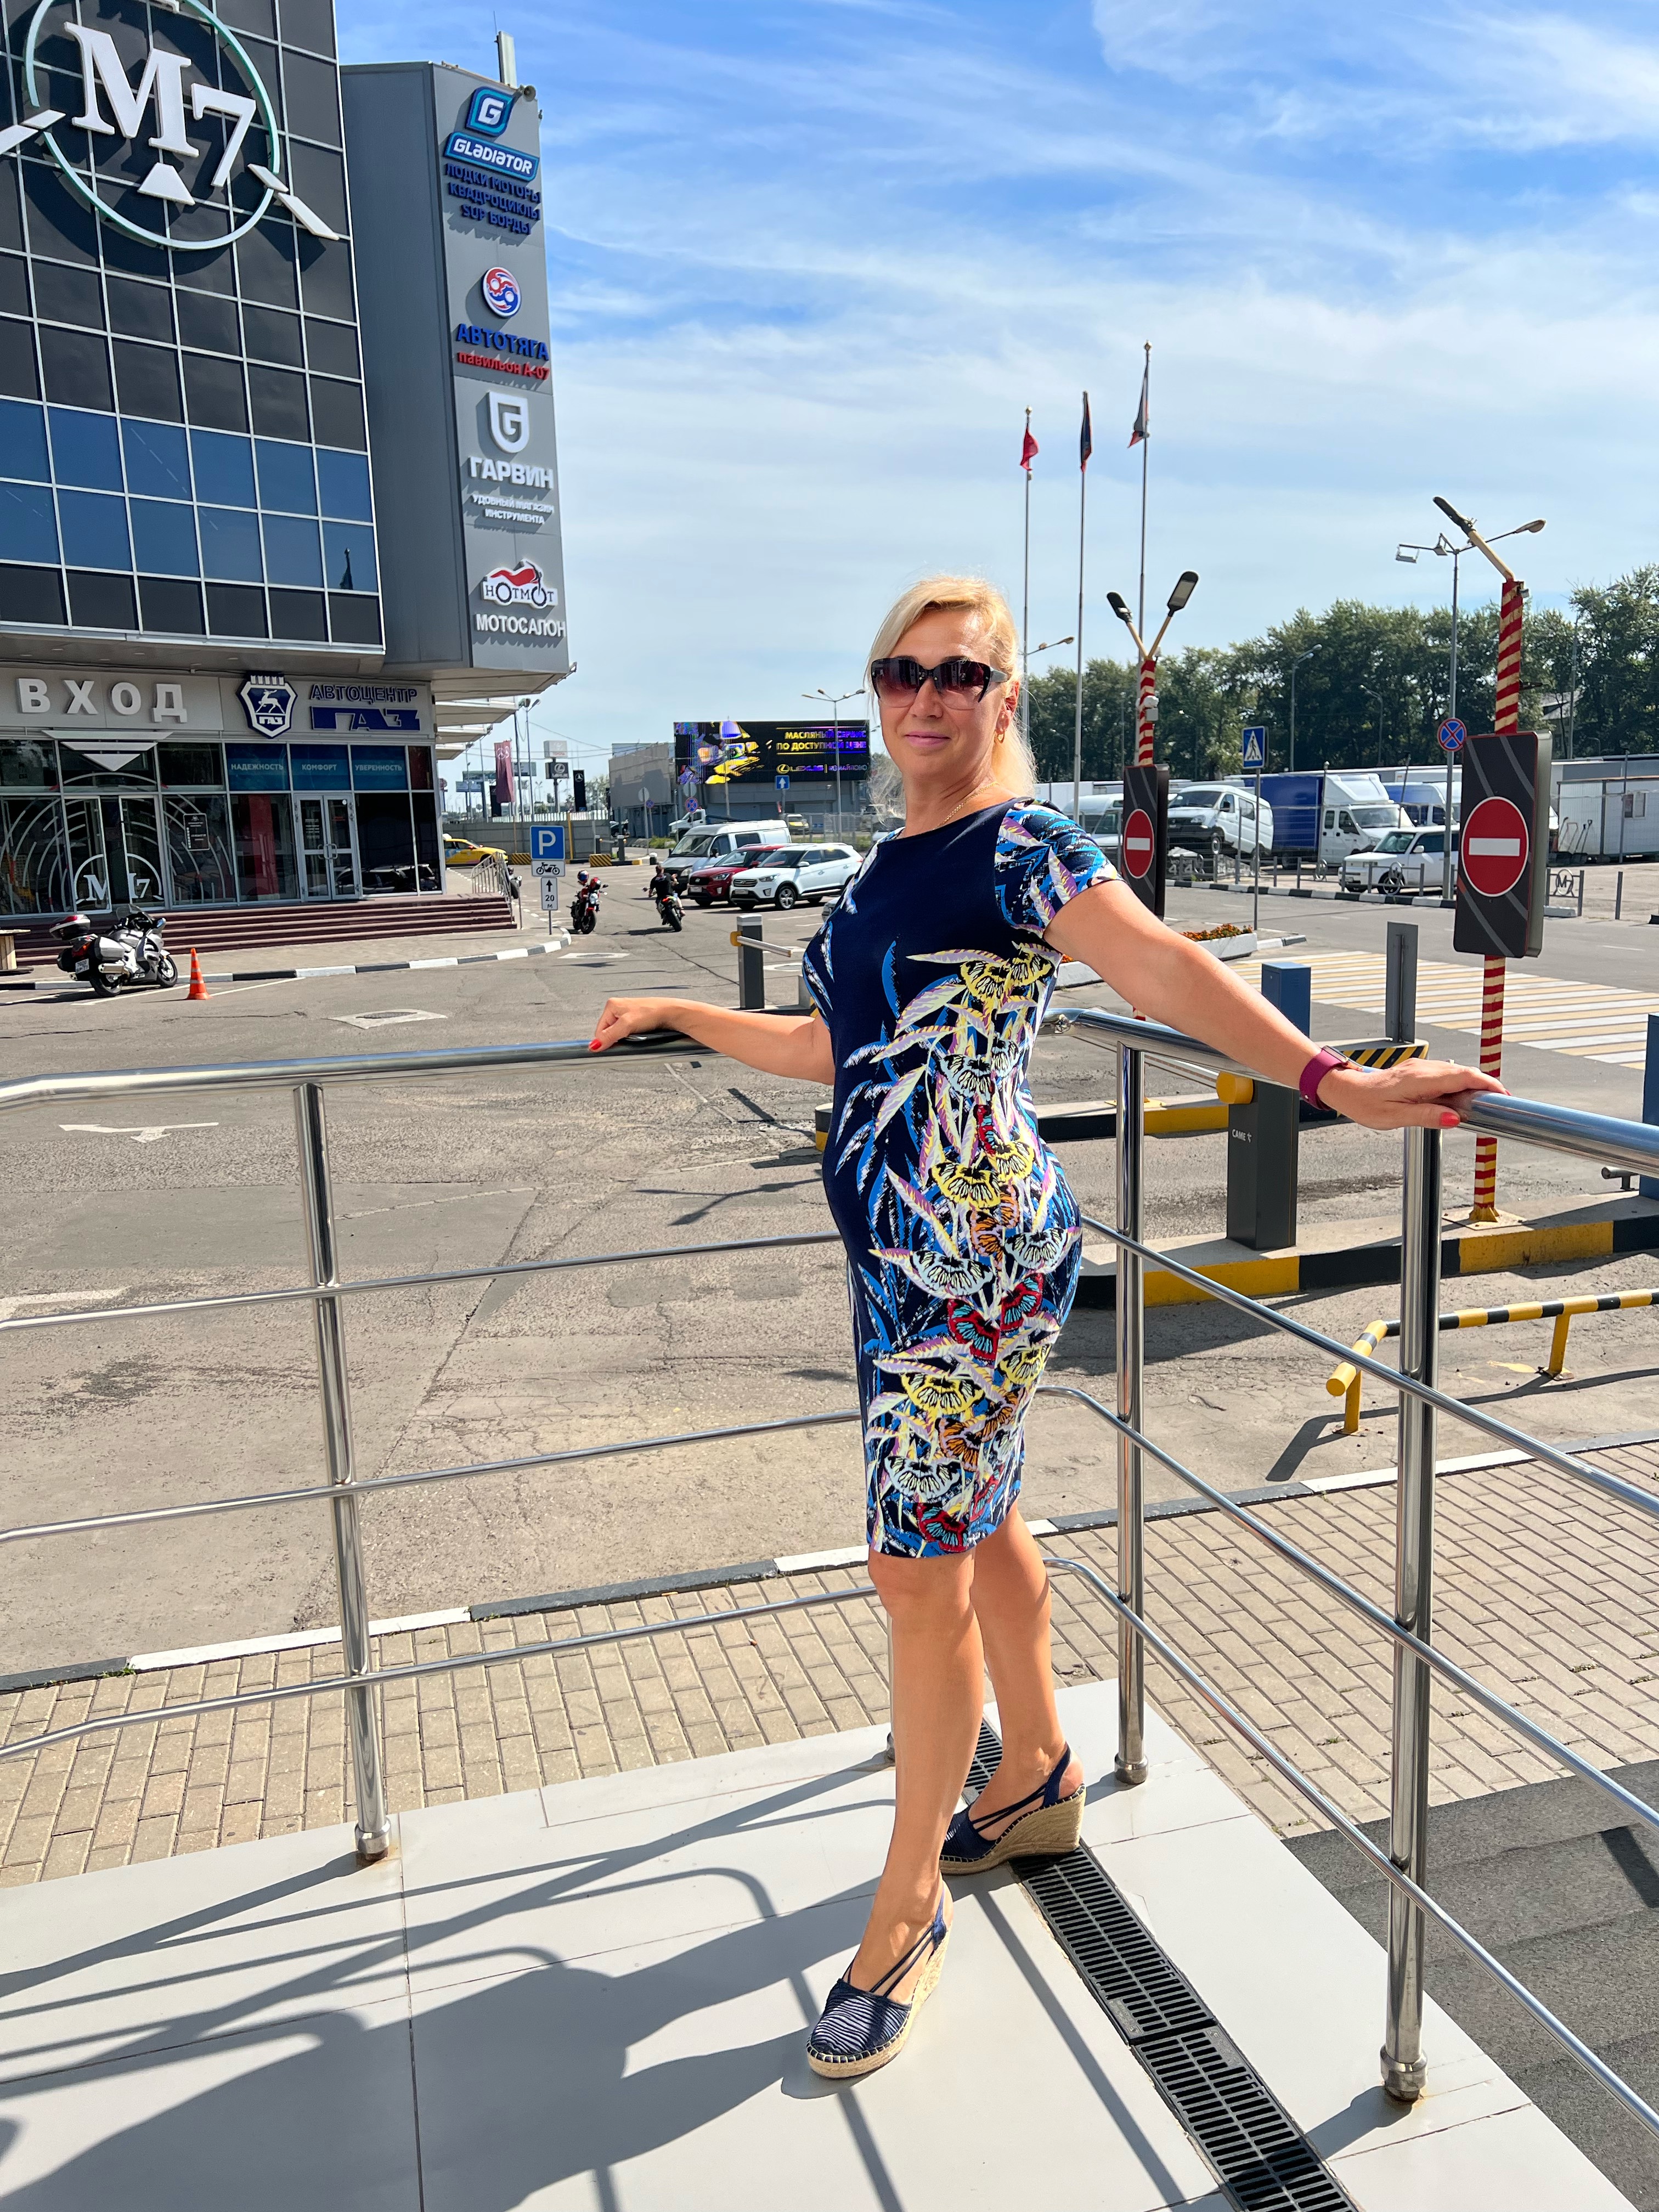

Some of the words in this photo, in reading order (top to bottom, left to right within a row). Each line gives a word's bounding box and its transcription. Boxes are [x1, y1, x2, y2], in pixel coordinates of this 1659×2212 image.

[64, 21, 256, 187] M7
[445, 163, 489, 187] ЛОДКИ
[489, 176, 541, 204] МОТОРЫ
[448, 182, 541, 221] КВАДРОЦИКЛЫ
[461, 204, 487, 221] SUP
[488, 211, 532, 235] БОРДЫ
[456, 323, 549, 361] АВТОТЯГА
[470, 456, 554, 489] ГАРВИН
[476, 614, 566, 637] МОТОСАЛОН
[17, 678, 188, 723] ВХОД
[309, 684, 418, 704] АВТОЦЕНТР
[259, 716, 283, 725] ГАЗ
[309, 706, 421, 731] ГАЗ
[776, 742, 790, 751] ПО
[785, 729, 834, 740] МАСЛЯНЫЙ
[538, 830, 556, 855] P
[1232, 1128, 1246, 1141] CAME
